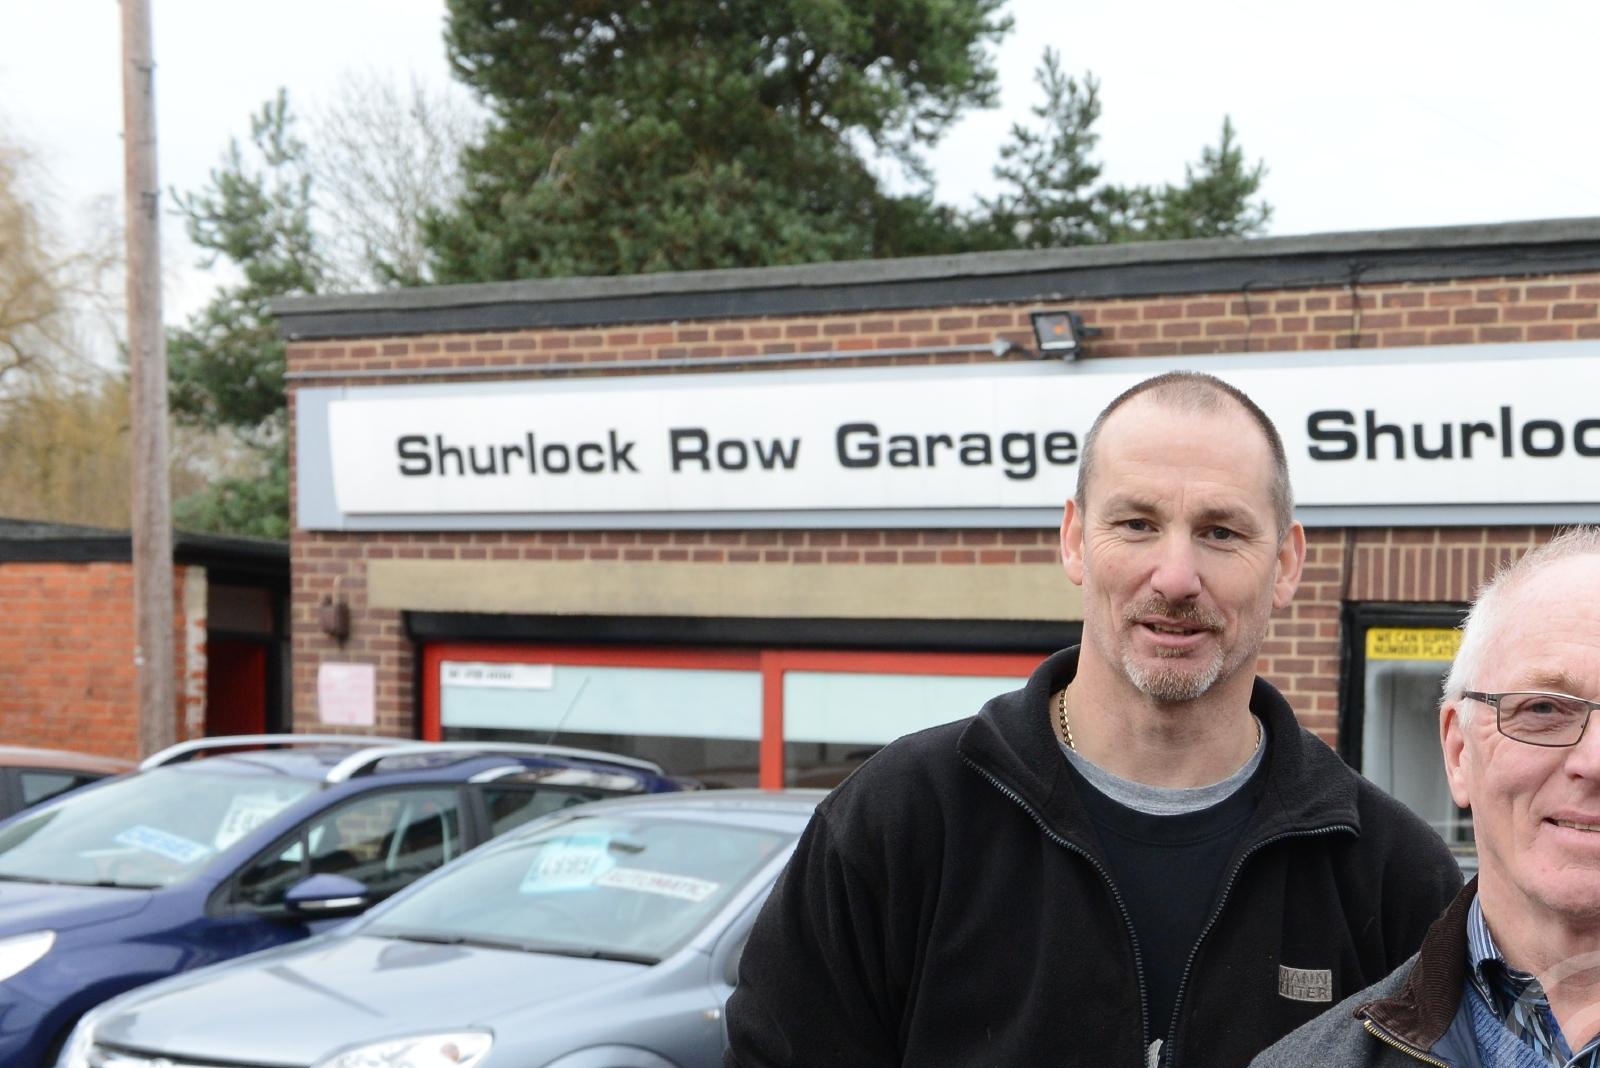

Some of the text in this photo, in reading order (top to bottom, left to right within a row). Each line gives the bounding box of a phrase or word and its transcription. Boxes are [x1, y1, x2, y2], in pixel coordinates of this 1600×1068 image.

[397, 429, 638, 477] Shurlock
[669, 427, 801, 472] Row
[835, 422, 1079, 481] Garage
[1395, 631, 1418, 643] CAN
[1373, 644, 1419, 656] NUMBER
